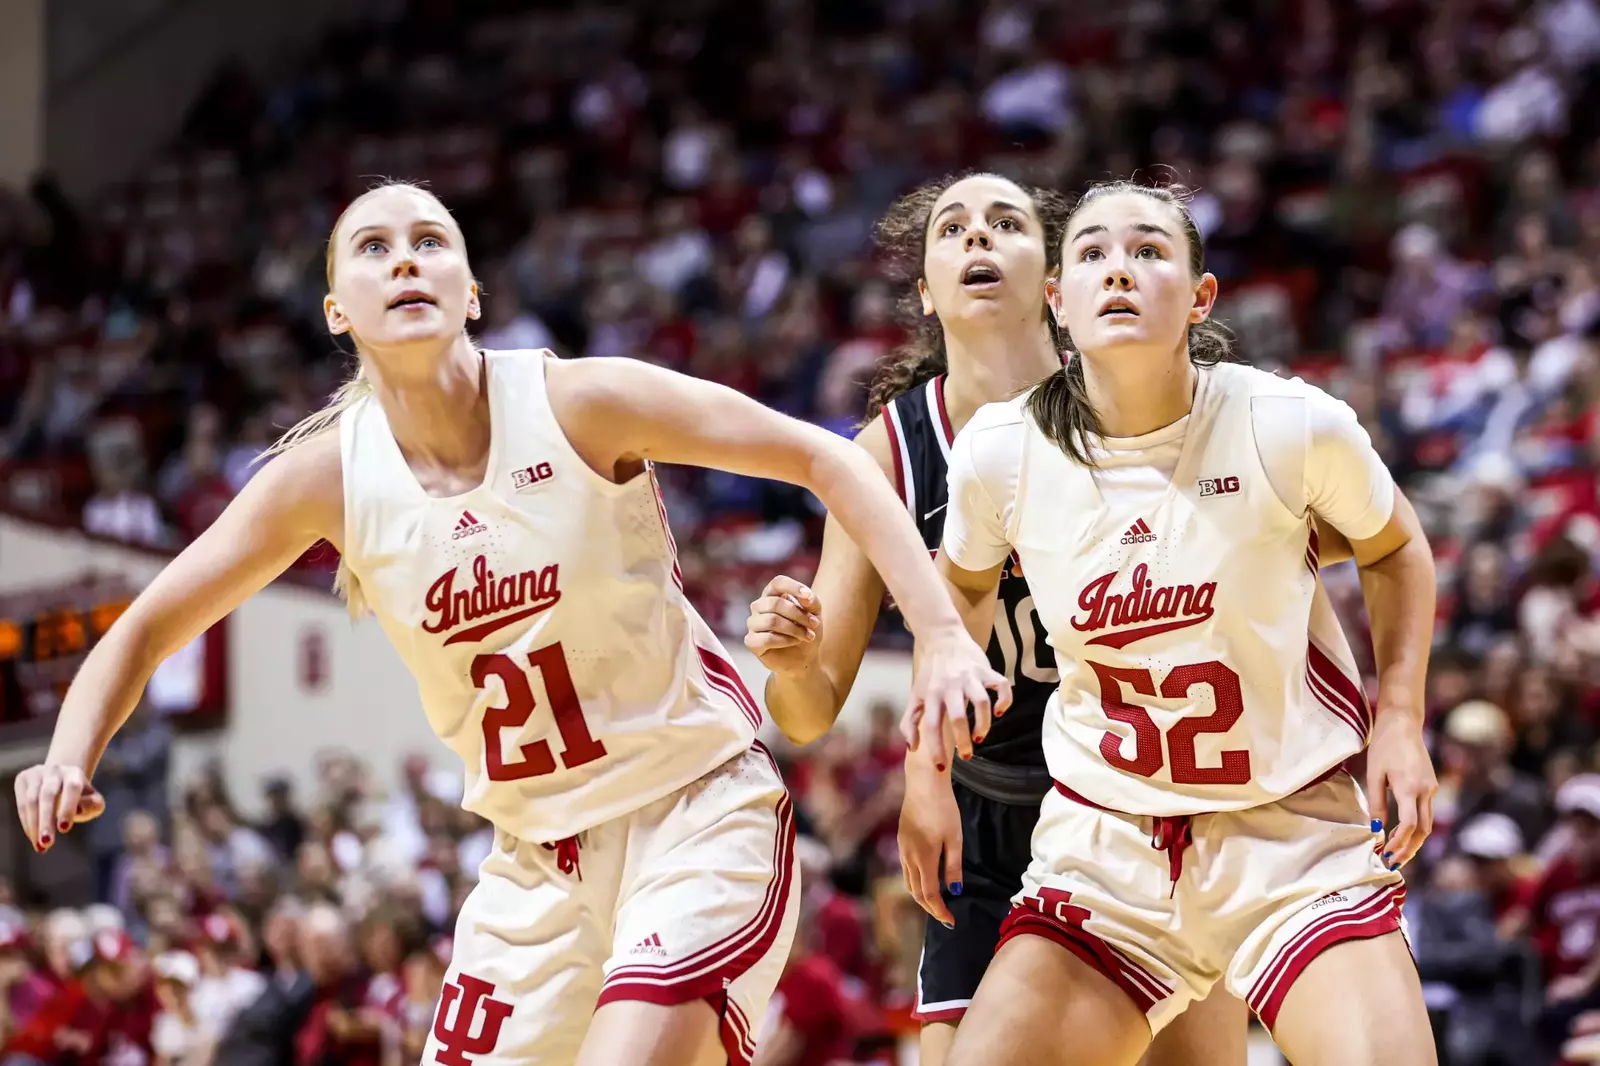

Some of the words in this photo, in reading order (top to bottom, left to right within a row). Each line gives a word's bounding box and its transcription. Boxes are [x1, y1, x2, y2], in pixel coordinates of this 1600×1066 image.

[451, 523, 487, 541] adidas
[1120, 532, 1157, 545] adidas
[422, 554, 561, 647] Indiana
[1070, 563, 1218, 650] Indiana
[470, 641, 608, 782] 21
[1084, 659, 1252, 785] 52
[1311, 895, 1349, 910] adidas
